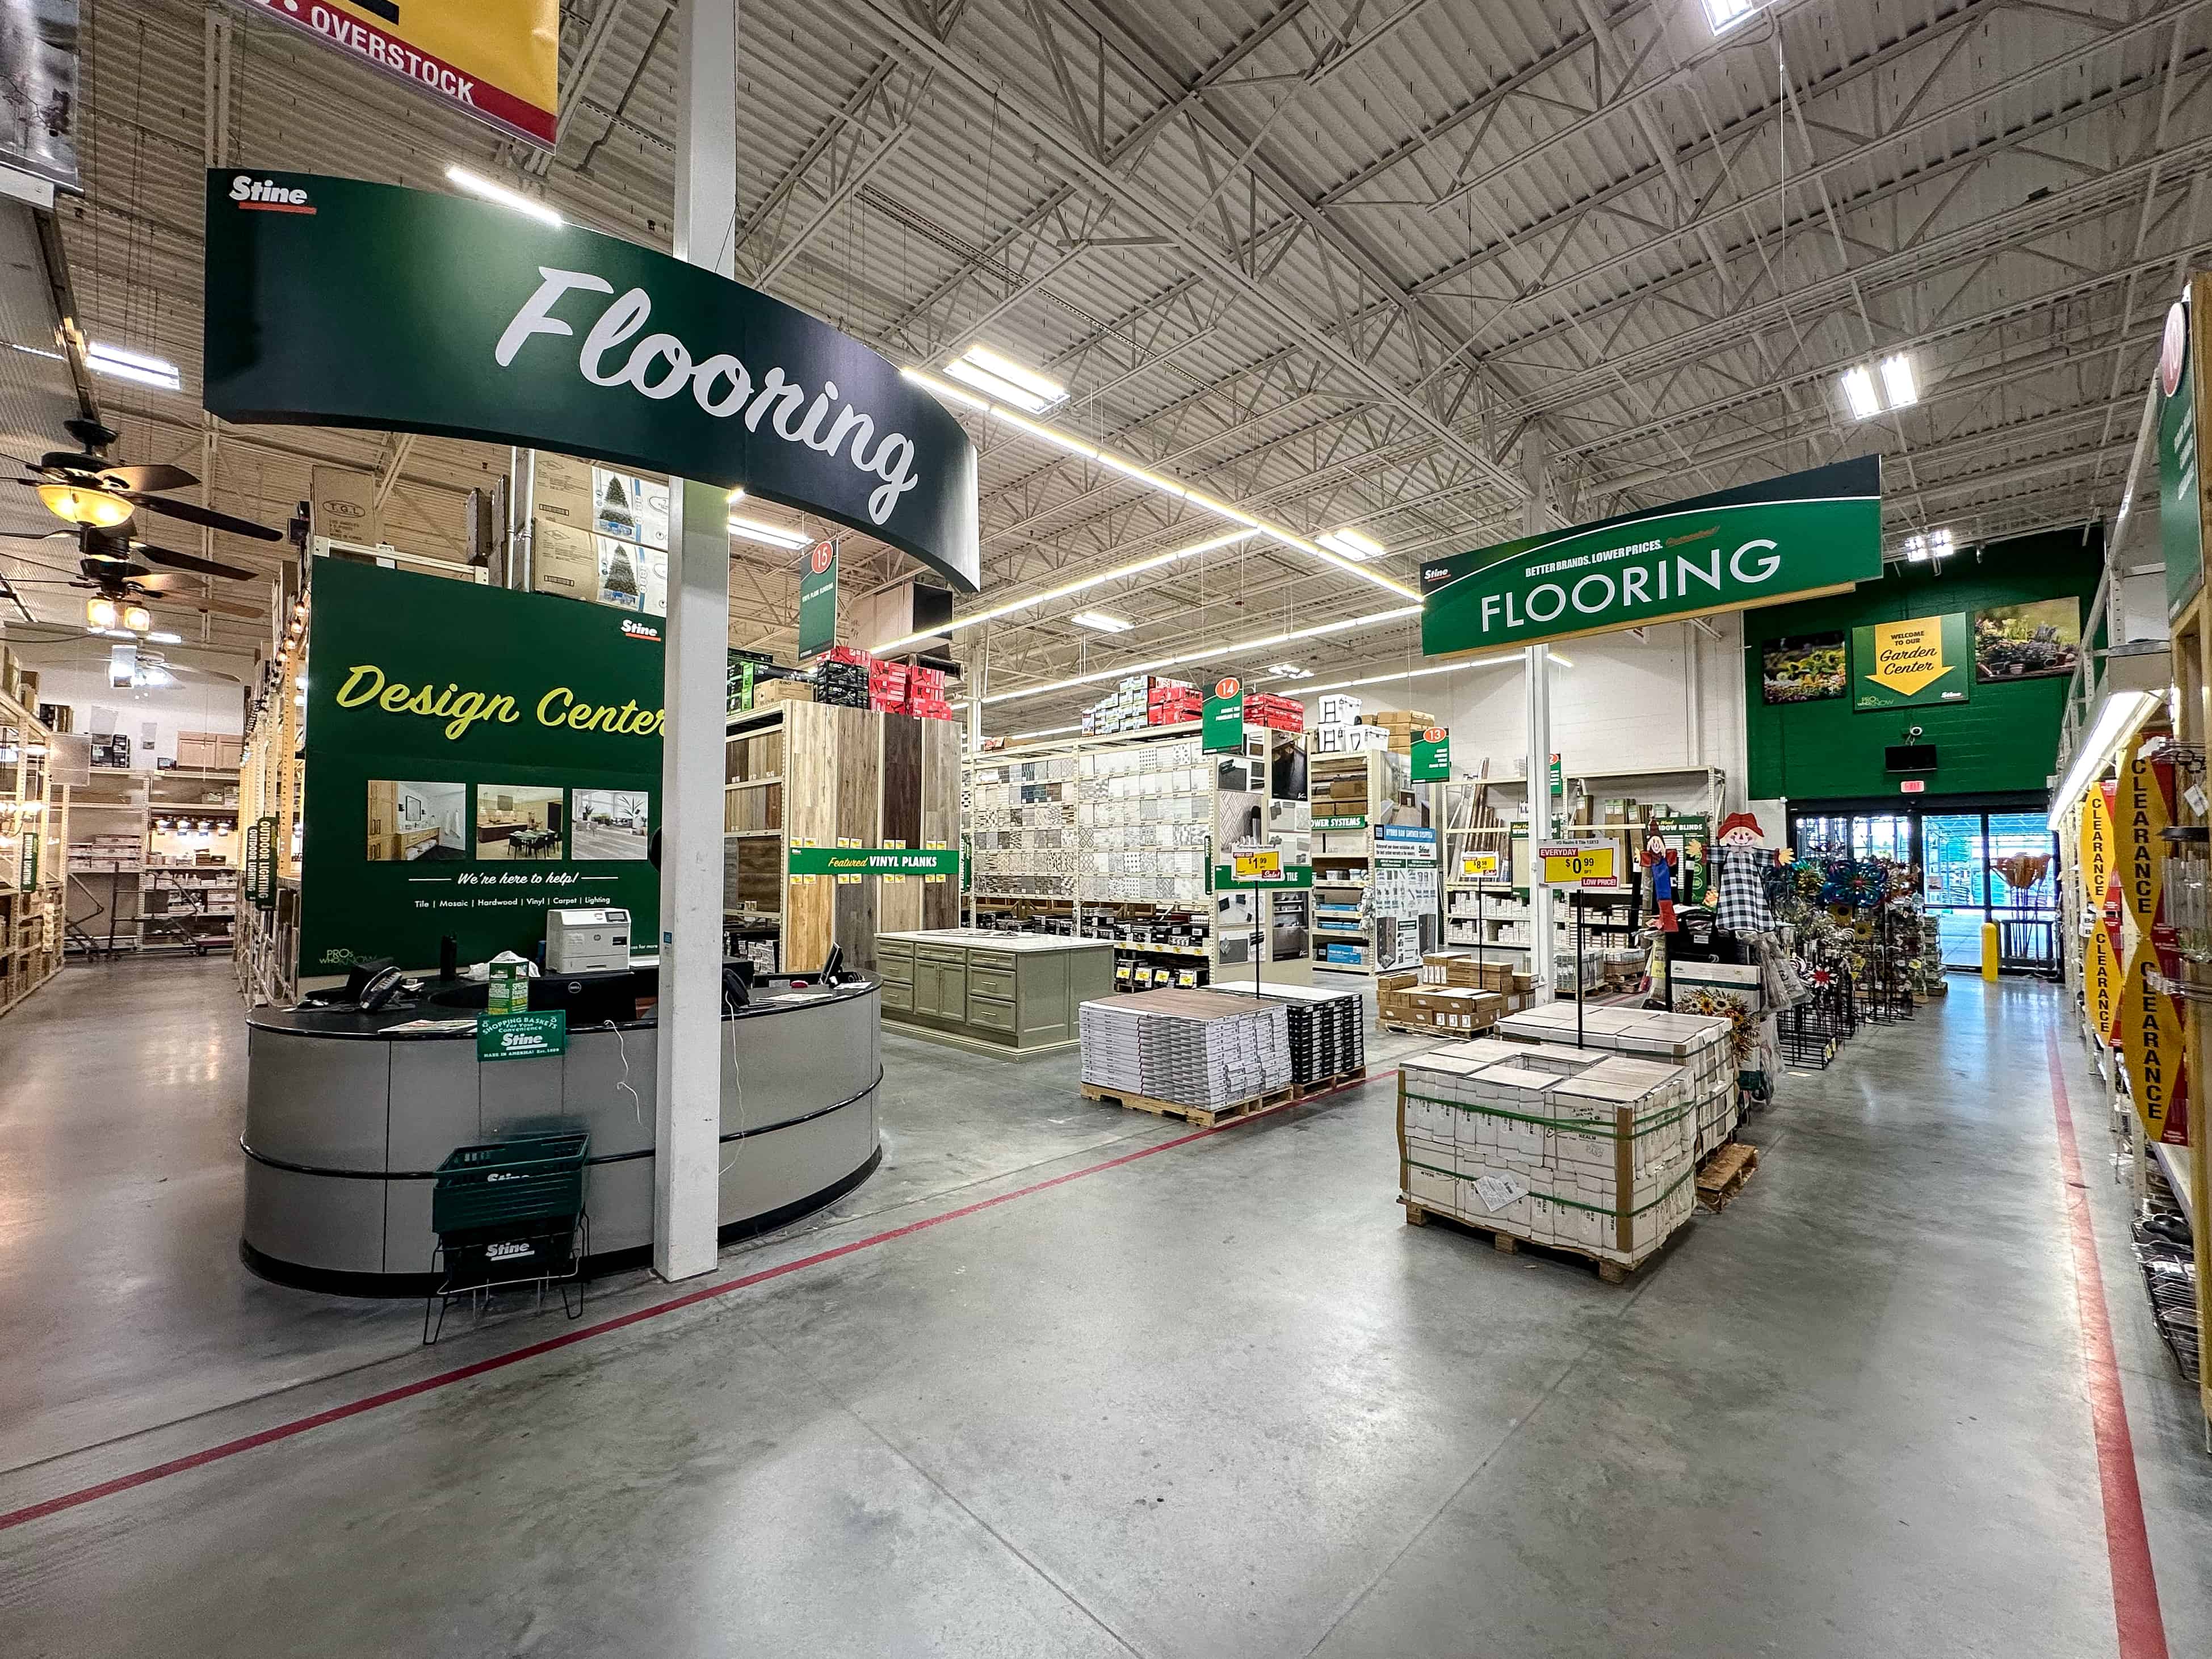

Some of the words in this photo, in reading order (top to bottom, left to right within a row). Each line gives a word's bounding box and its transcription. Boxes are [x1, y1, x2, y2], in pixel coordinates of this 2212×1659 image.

[310, 5, 476, 106] OVERSTOCK
[229, 175, 308, 205] Stine
[494, 266, 918, 526] Flooring
[817, 547, 828, 568] 15
[1525, 562, 1556, 578] BETTER
[1556, 556, 1591, 570] BRANDS.
[1592, 547, 1625, 564] LOWER
[1626, 539, 1663, 556] PRICES.
[1424, 568, 1449, 579] Stine
[1480, 538, 1781, 632] FLOORING
[620, 619, 658, 636] Stine
[1890, 631, 1925, 640] WELCOME
[1880, 646, 1937, 662] Garden
[1883, 661, 1934, 675] Center
[1222, 681, 1234, 695] 14
[335, 664, 519, 740] Design
[536, 687, 665, 736] Center
[1429, 731, 1441, 740] 13
[1311, 818, 1329, 828] OWER
[1330, 817, 1361, 827] SYSTEMS
[248, 829, 258, 860] OUTDOOR
[259, 821, 271, 860] OUTDOOR
[2131, 758, 2152, 914] CLEARANCE
[2092, 798, 2105, 896] CLEARANCE
[828, 856, 868, 868] Featured
[869, 855, 899, 867] VINYL
[901, 856, 937, 868] PLANKS
[247, 862, 257, 892] LIGHTING
[258, 862, 270, 899] LIGHTING
[457, 872, 496, 885] We're
[498, 872, 528, 884] here
[530, 872, 543, 884] to
[545, 871, 580, 886] help!
[1286, 871, 1298, 881] TILE
[477, 898, 518, 907] Hardwood
[526, 897, 545, 906] Vinyl
[553, 897, 577, 906] Carpet
[584, 896, 611, 906] Lighting
[2096, 933, 2110, 1033] CLEARANCE
[482, 1017, 522, 1035] SHOPPING
[524, 1017, 558, 1030] BASKETS
[501, 1032, 543, 1047] Stine
[2140, 961, 2163, 1120] CLEARANCE
[486, 1173, 530, 1182] Sti
[485, 1242, 530, 1257] Stine
